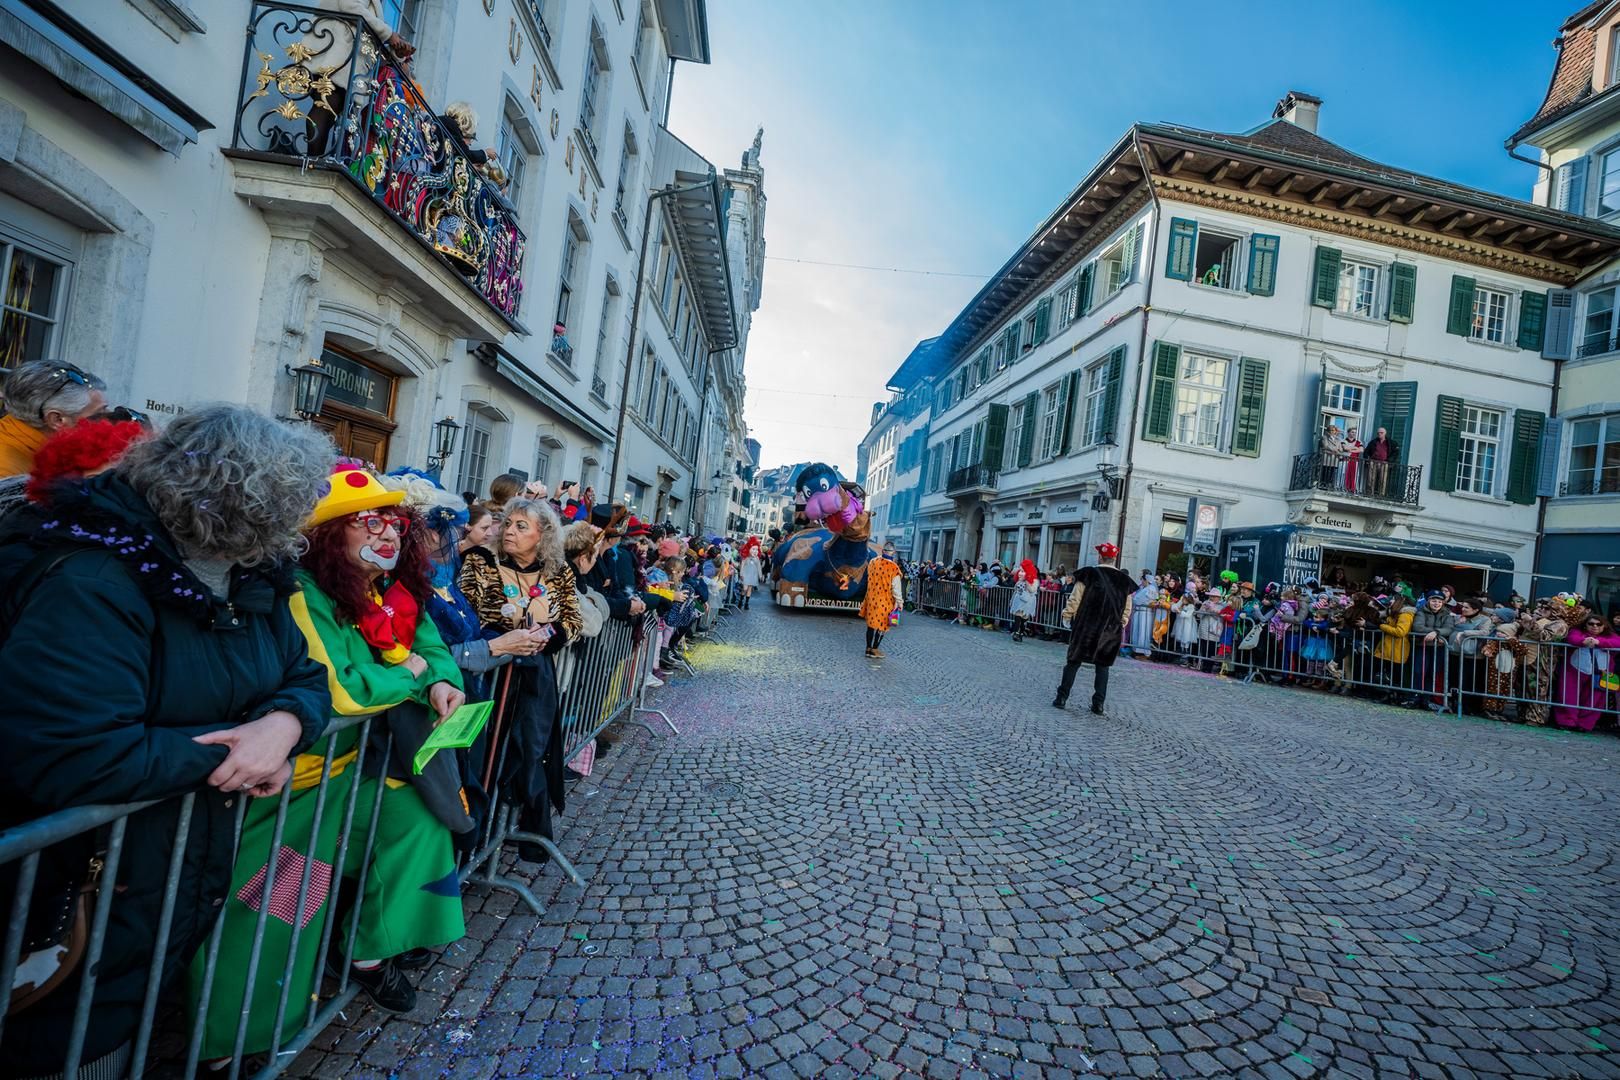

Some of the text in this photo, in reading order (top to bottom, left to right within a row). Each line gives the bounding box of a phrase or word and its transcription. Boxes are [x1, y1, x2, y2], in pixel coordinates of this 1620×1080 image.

[321, 361, 375, 400] OURONNE
[146, 399, 175, 414] Hotel
[1314, 515, 1352, 528] Cafeteria
[1285, 542, 1320, 561] MIETEN
